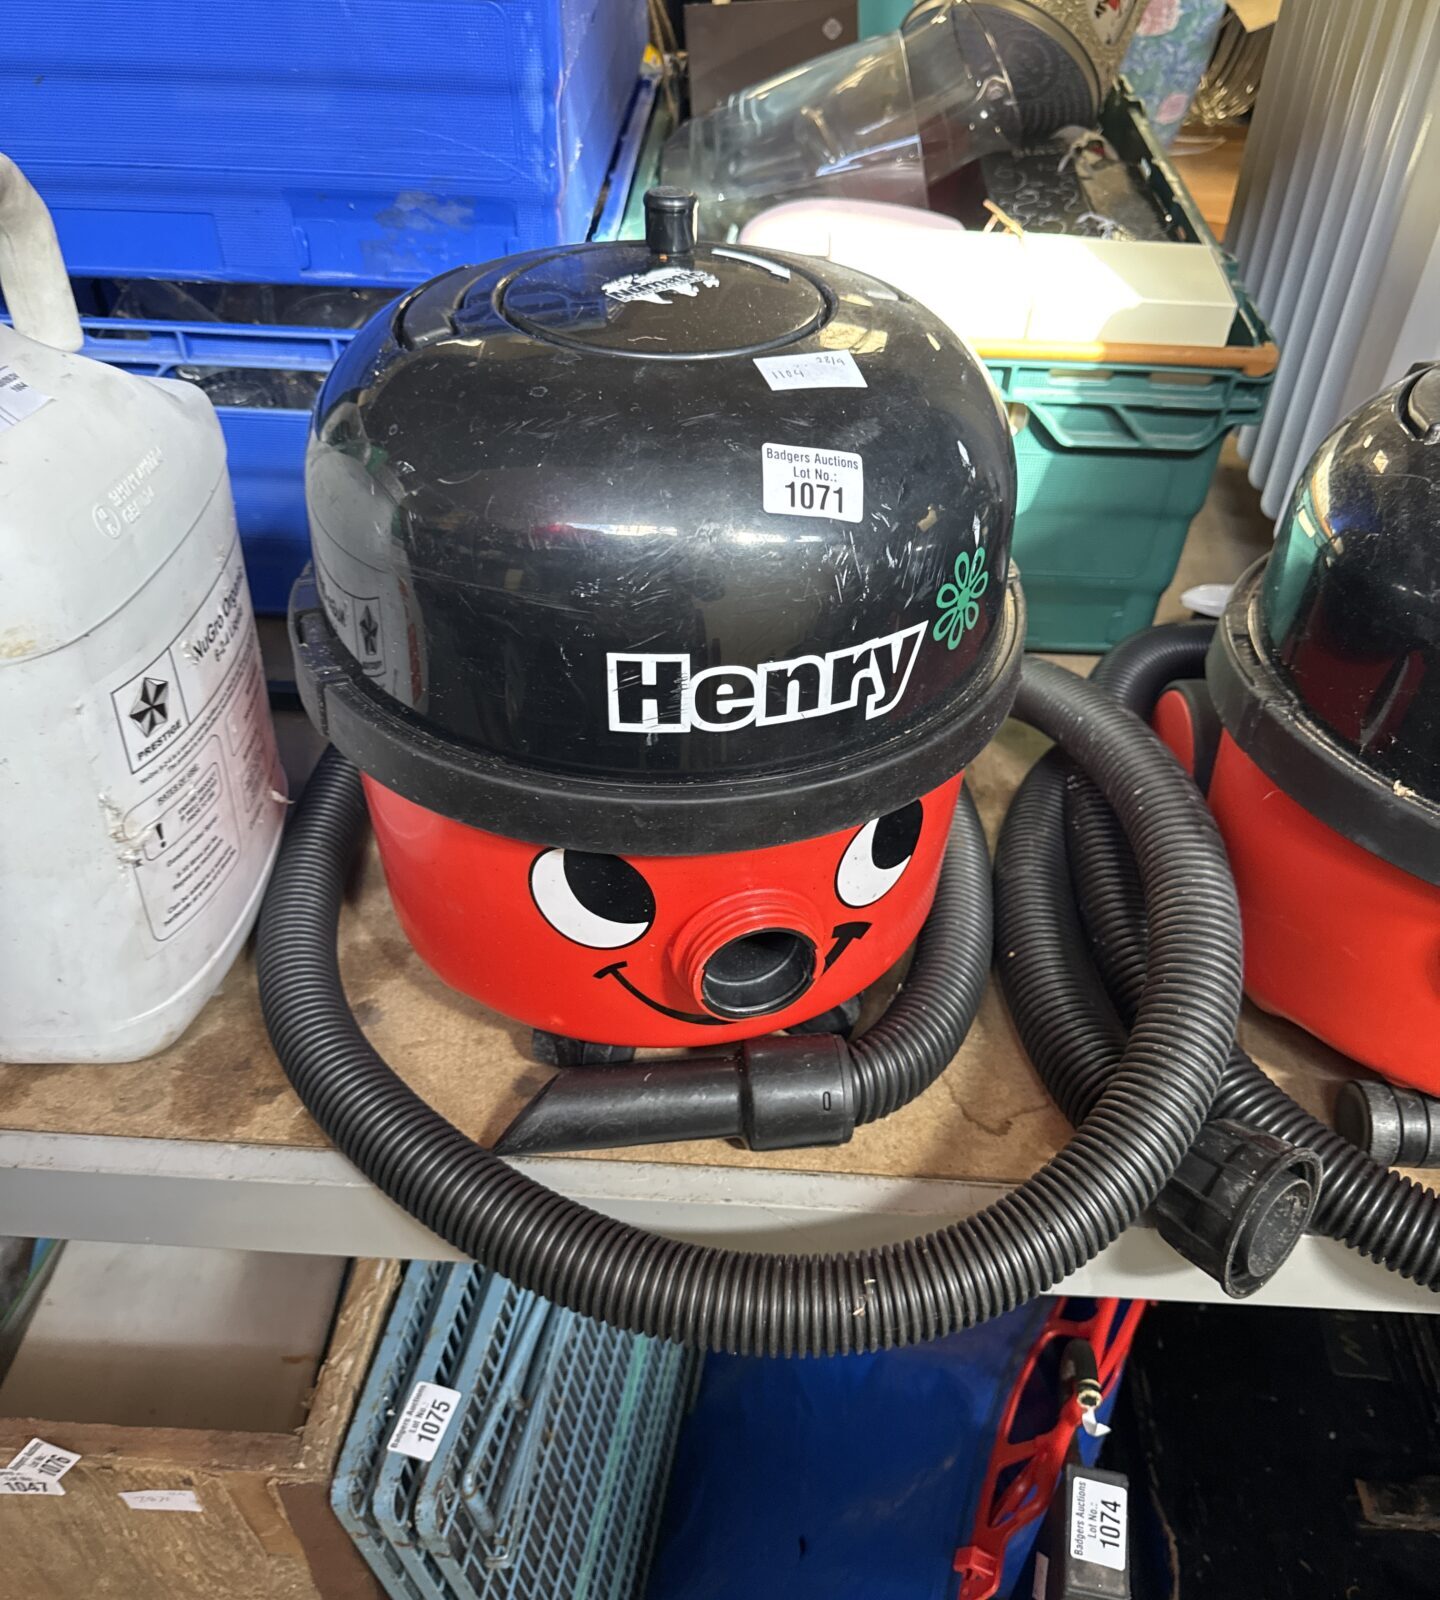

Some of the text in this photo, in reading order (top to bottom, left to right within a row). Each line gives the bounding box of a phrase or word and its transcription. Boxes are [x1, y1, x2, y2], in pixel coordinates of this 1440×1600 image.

[608, 271, 707, 301] Numatic
[766, 447, 859, 470] Badgers Auctions
[793, 466, 838, 483] Lot No.:
[784, 481, 843, 514] 1071
[606, 620, 929, 733] Henry
[137, 719, 182, 762] PRESTIGE
[417, 1399, 451, 1442] 1075
[38, 1454, 71, 1477] 1076
[4, 1481, 48, 1492] 1047
[1074, 1481, 1087, 1556] Badgers Auctions
[1087, 1523, 1098, 1539] Lot
[1099, 1499, 1122, 1550] 1074
